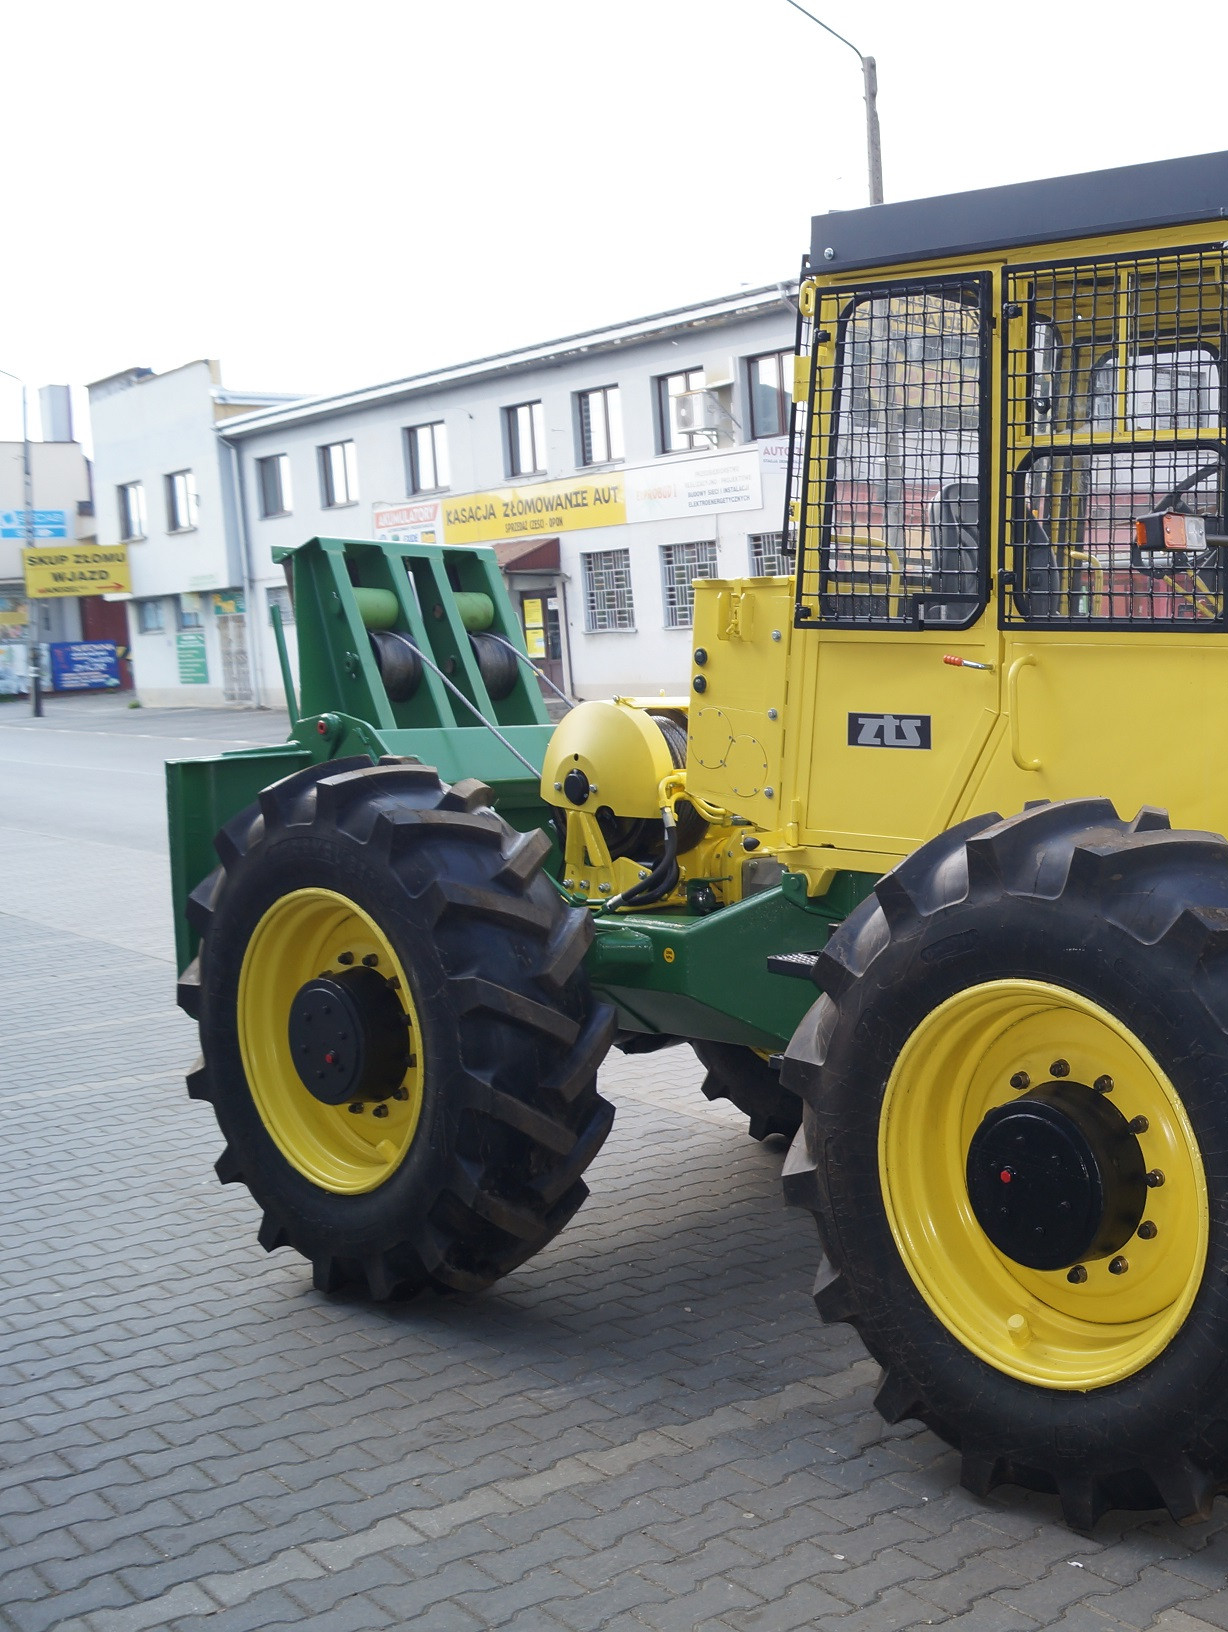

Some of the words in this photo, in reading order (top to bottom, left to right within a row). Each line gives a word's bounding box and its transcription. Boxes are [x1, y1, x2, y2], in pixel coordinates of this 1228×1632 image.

[446, 503, 497, 526] KASACJA
[503, 489, 588, 518] ZŁOMOWANIE
[593, 486, 618, 506] AUT
[27, 554, 68, 566] SKUP
[73, 552, 125, 564] ZŁOMU
[51, 569, 110, 582] WJAZD
